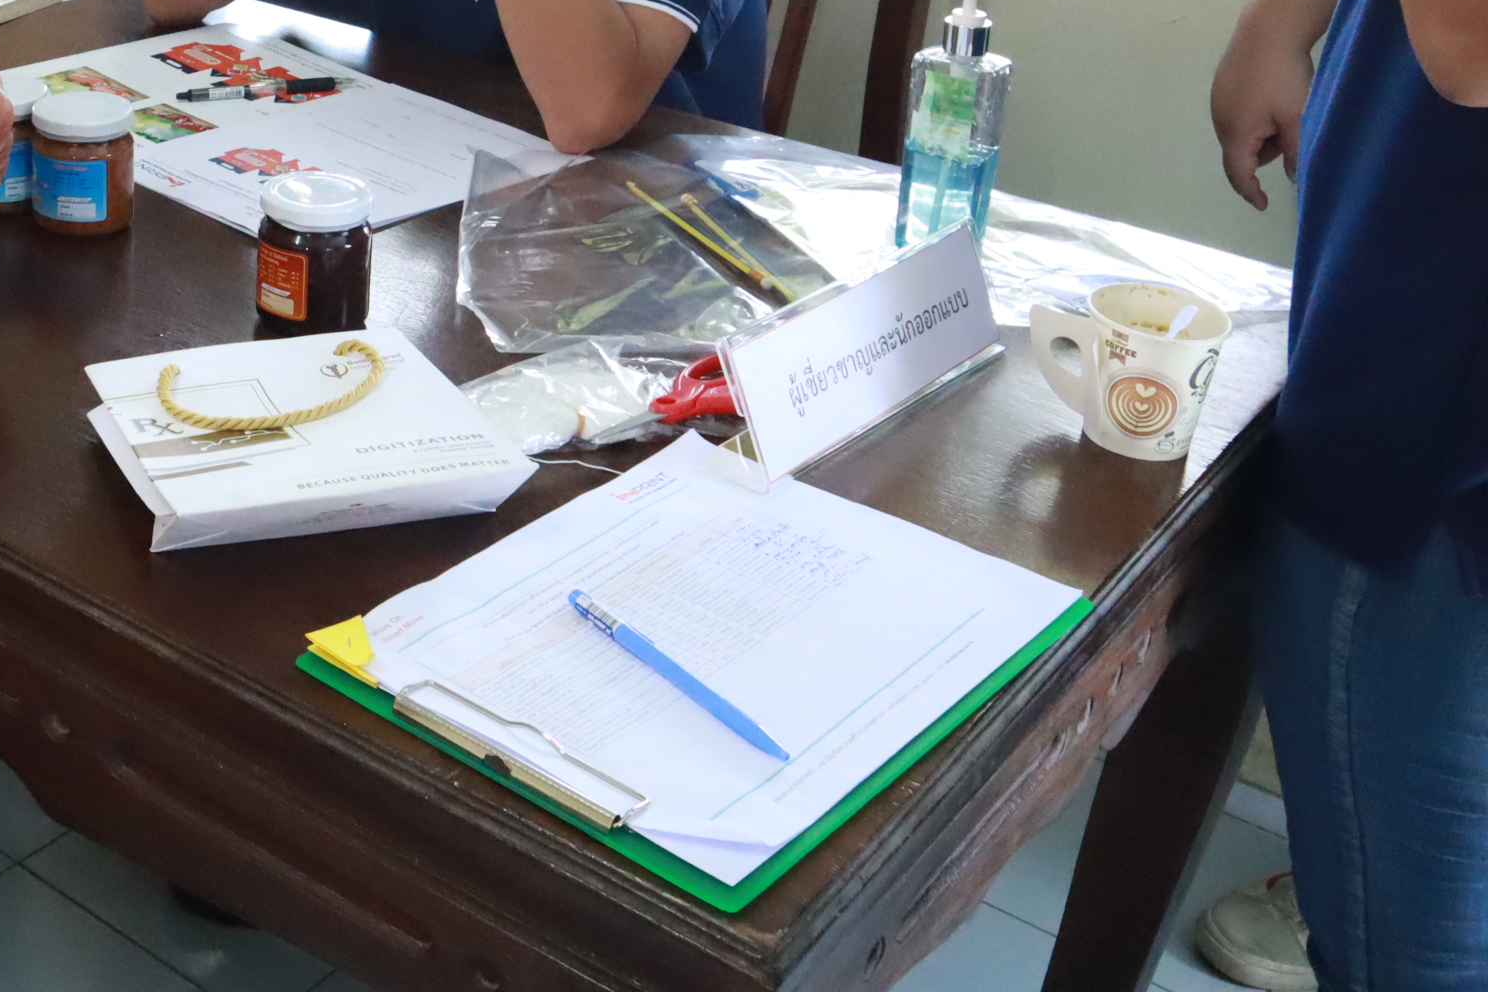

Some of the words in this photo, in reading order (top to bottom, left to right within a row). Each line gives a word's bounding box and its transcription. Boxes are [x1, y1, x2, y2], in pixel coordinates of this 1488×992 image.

[788, 287, 970, 418] ผู้เชี่ยวชาญและนักออกแบบ
[1105, 339, 1138, 359] COFFEE
[349, 358, 406, 370] Interional
[355, 433, 486, 454] DIGITIZATION
[296, 476, 358, 490] BECAUSE
[360, 469, 418, 481] QUALITY
[420, 462, 457, 474] DOES
[458, 459, 511, 468] MATTER
[369, 622, 392, 637] Move
[389, 614, 404, 624] On
[380, 627, 406, 644] Smart
[401, 615, 425, 631] Move
